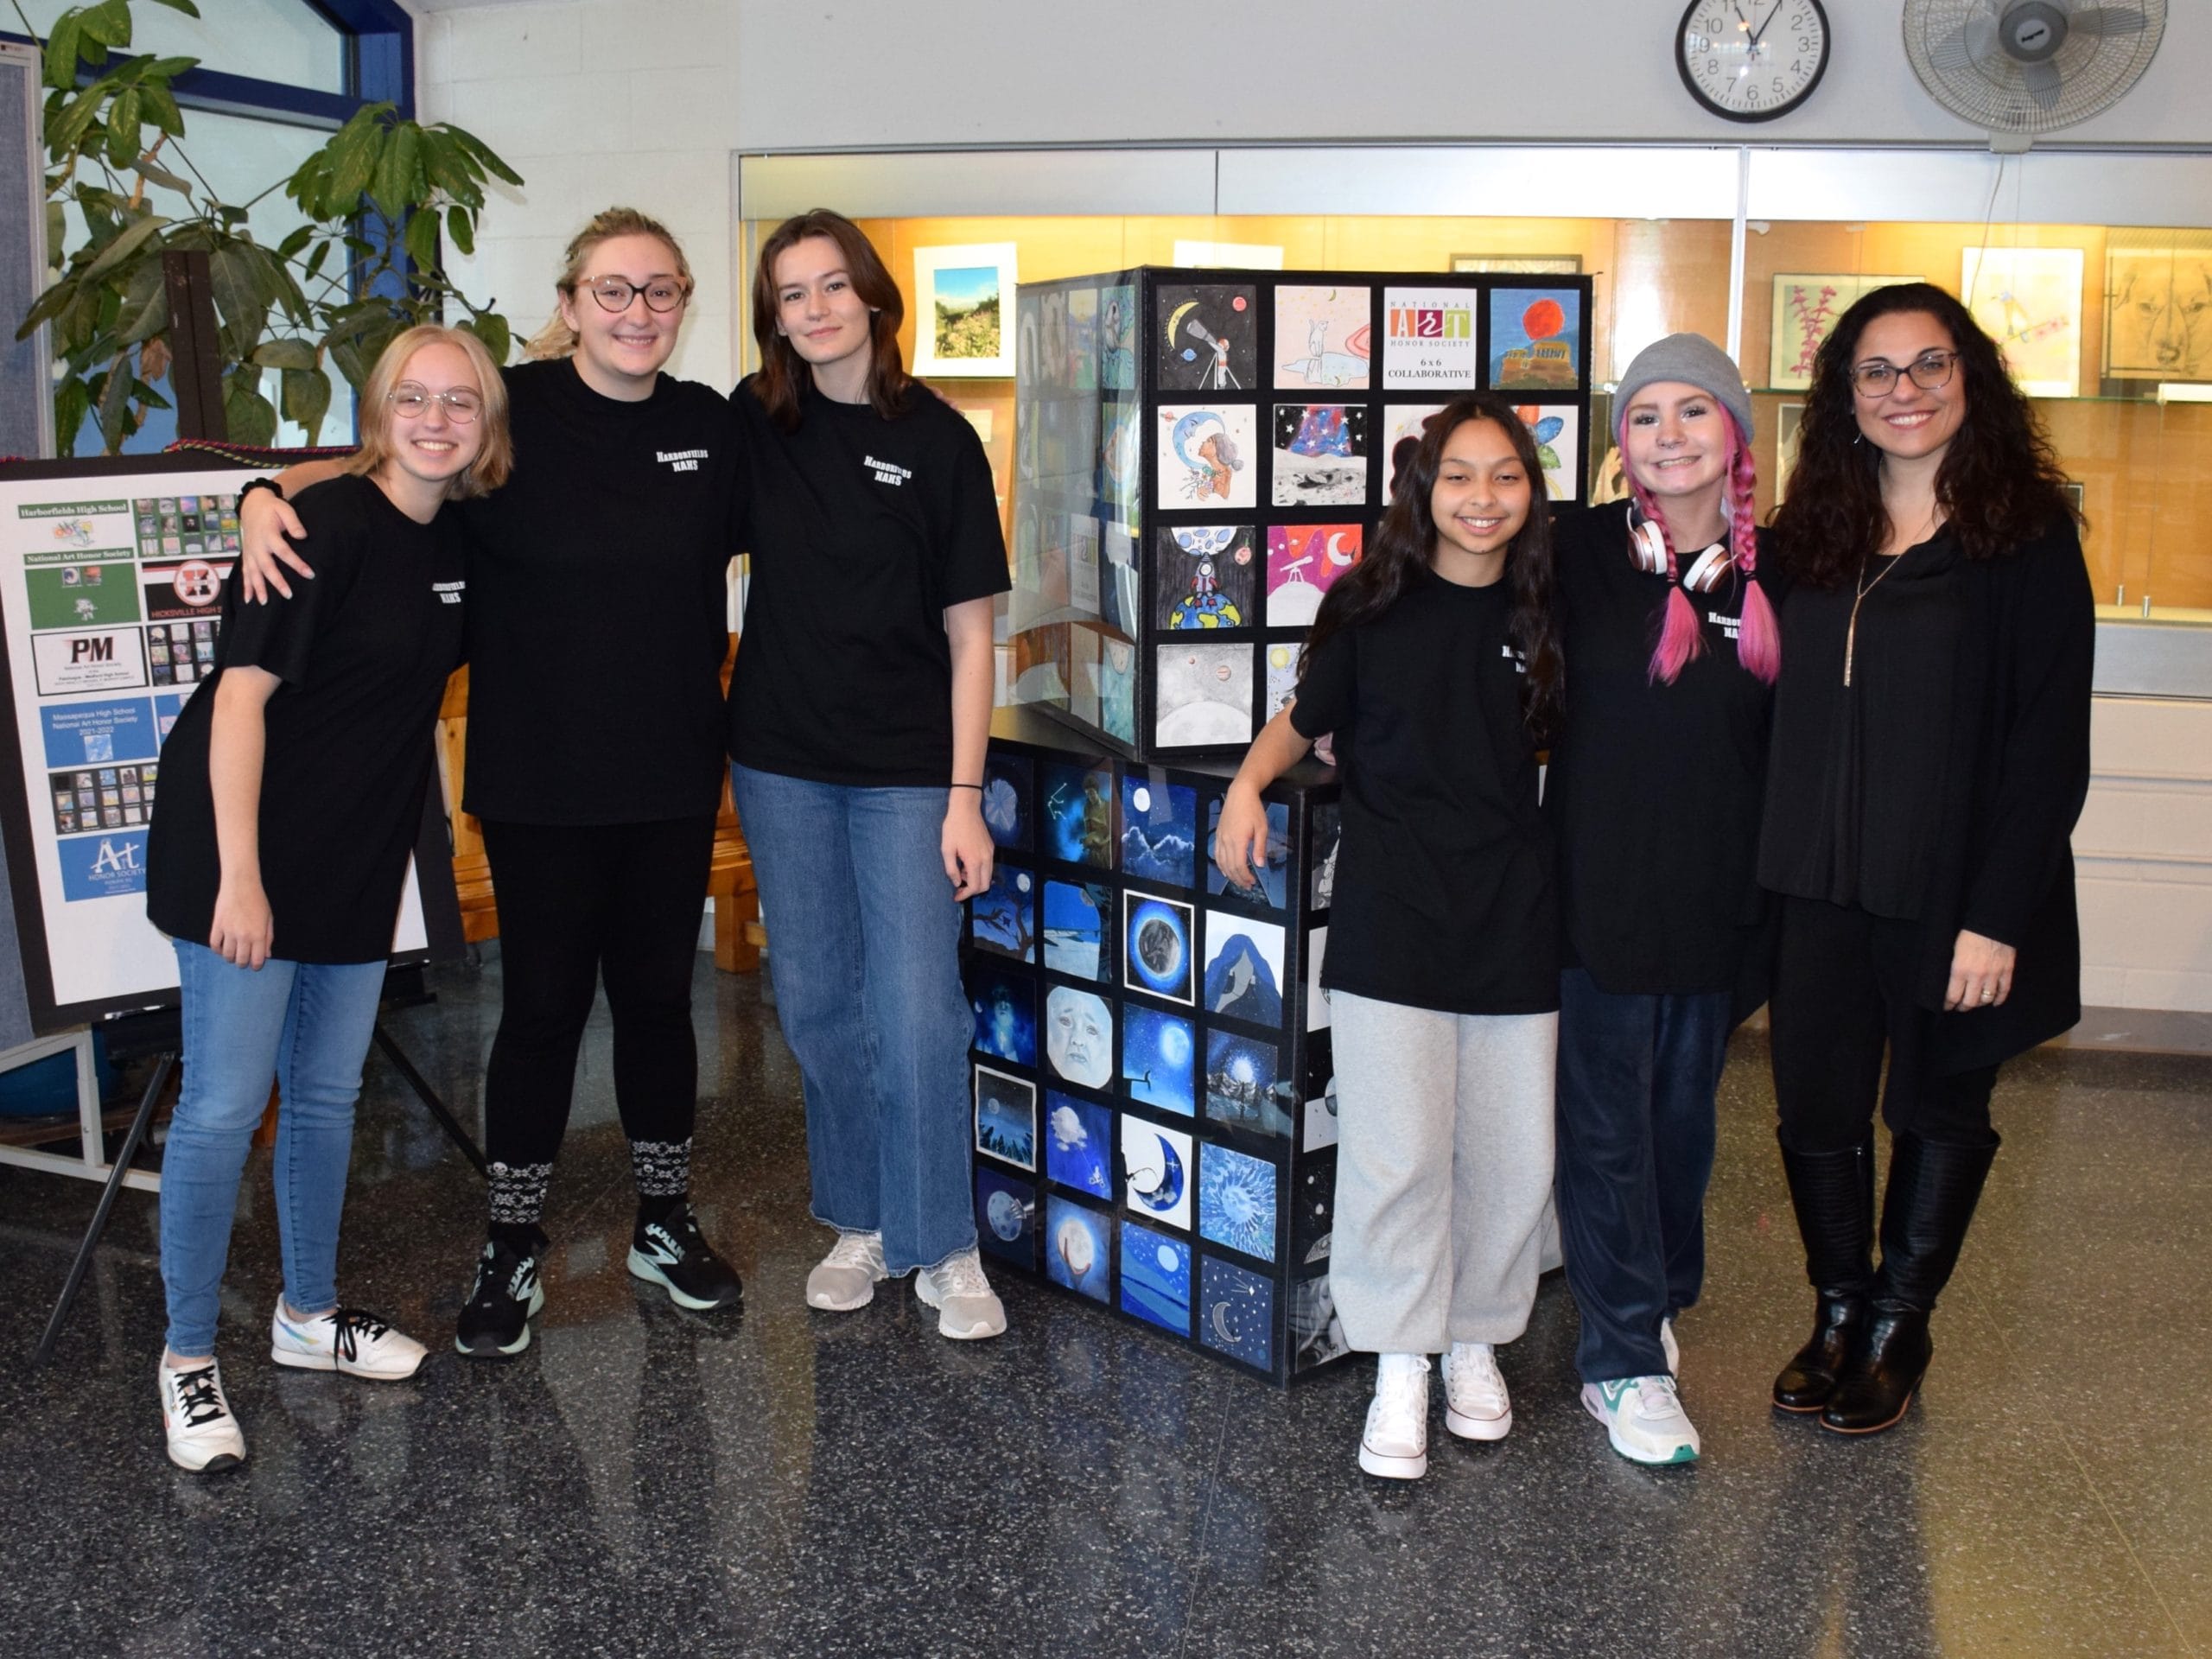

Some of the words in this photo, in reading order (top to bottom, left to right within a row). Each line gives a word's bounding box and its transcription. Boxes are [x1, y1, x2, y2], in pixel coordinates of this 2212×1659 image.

[1705, 17, 1724, 34] 10
[1791, 15, 1803, 31] 2
[1700, 37, 1711, 54] 9
[1798, 36, 1810, 53] 3
[1707, 59, 1719, 75] 8
[1790, 59, 1802, 74] 4
[1726, 77, 1737, 92] 7
[1772, 77, 1784, 93] 5
[1746, 85, 1758, 101] 6
[1420, 358, 1427, 366] 6
[1435, 358, 1442, 366] 6
[1388, 369, 1471, 379] COLLABORATIVE
[874, 470, 903, 486] NAHS
[21, 506, 75, 517] Harborfields
[77, 505, 97, 515] High
[99, 503, 127, 512] School
[28, 554, 60, 563] National
[76, 551, 102, 560] Honor
[103, 550, 131, 558] Society
[71, 636, 113, 664] PM
